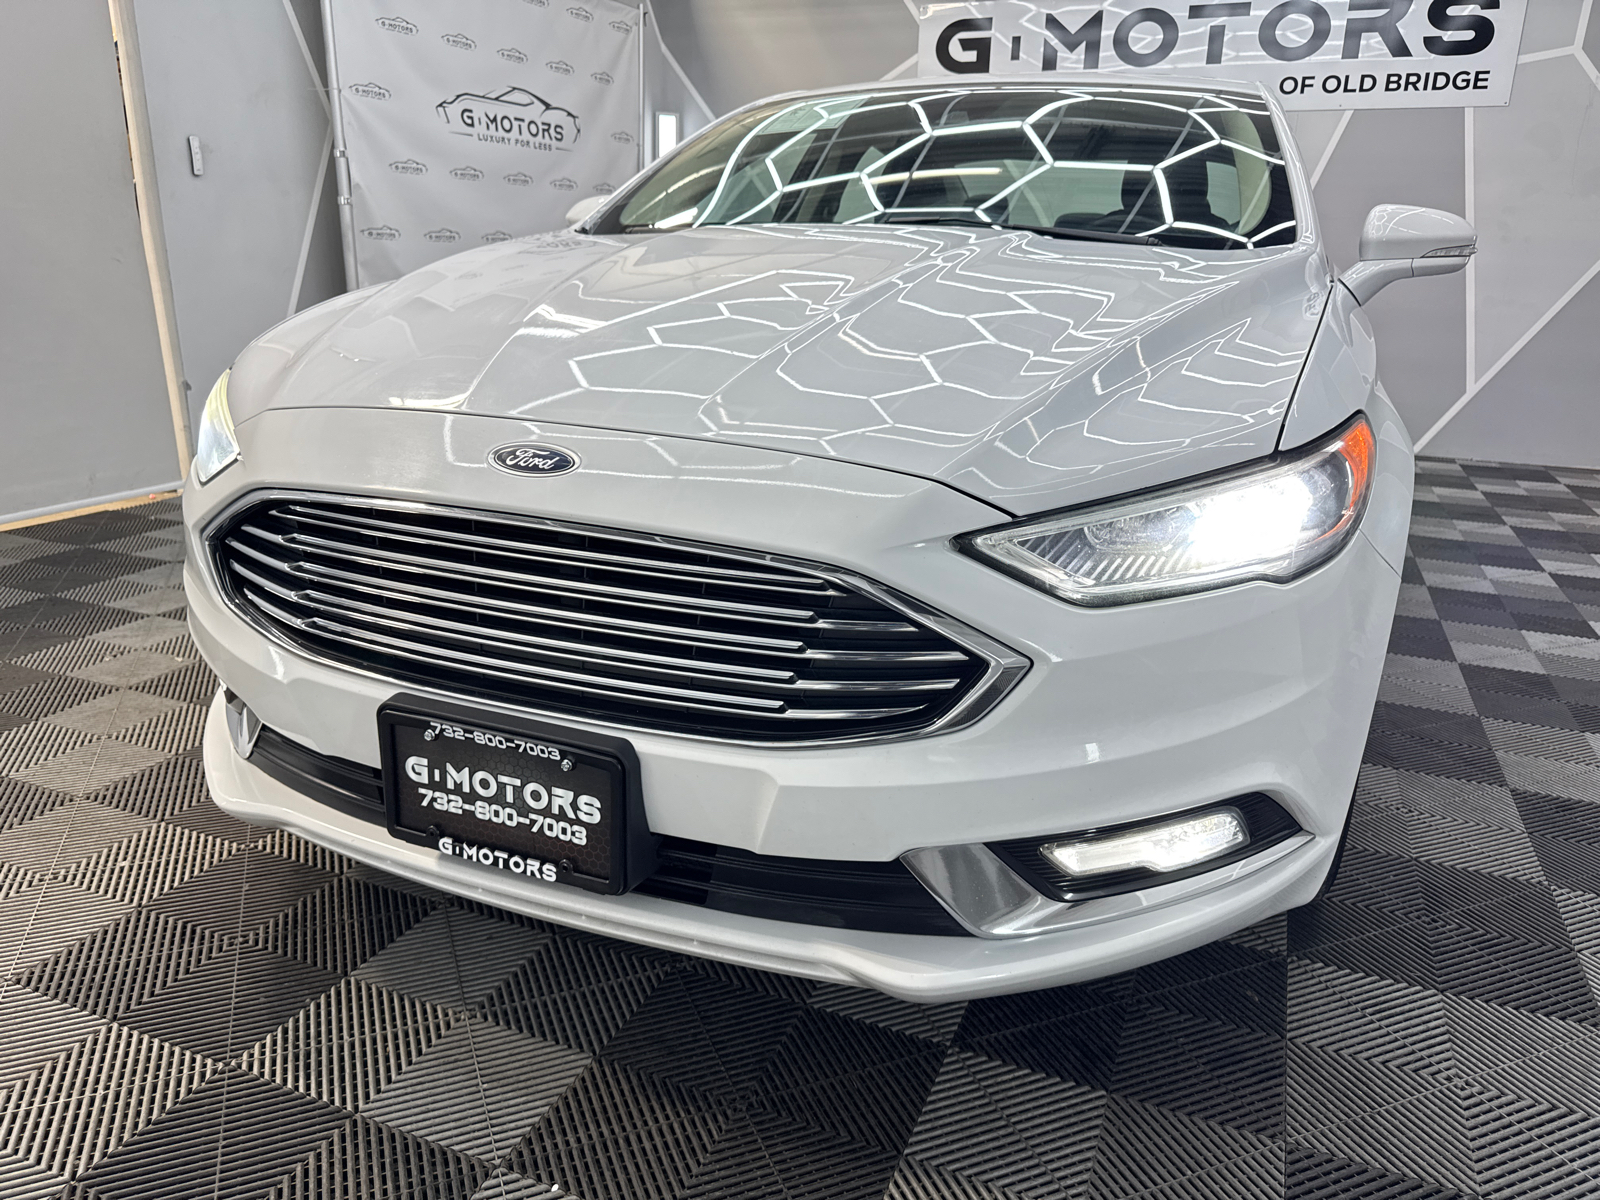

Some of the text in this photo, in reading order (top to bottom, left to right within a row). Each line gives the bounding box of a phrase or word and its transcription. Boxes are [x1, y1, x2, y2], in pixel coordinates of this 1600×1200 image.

[1279, 70, 1491, 95] OF OLD BRIDGE
[477, 133, 552, 152] LUXURY FOR LESS
[505, 447, 561, 470] Ford
[430, 721, 561, 761] 732-800-7003
[418, 787, 588, 847] 732-800-7003
